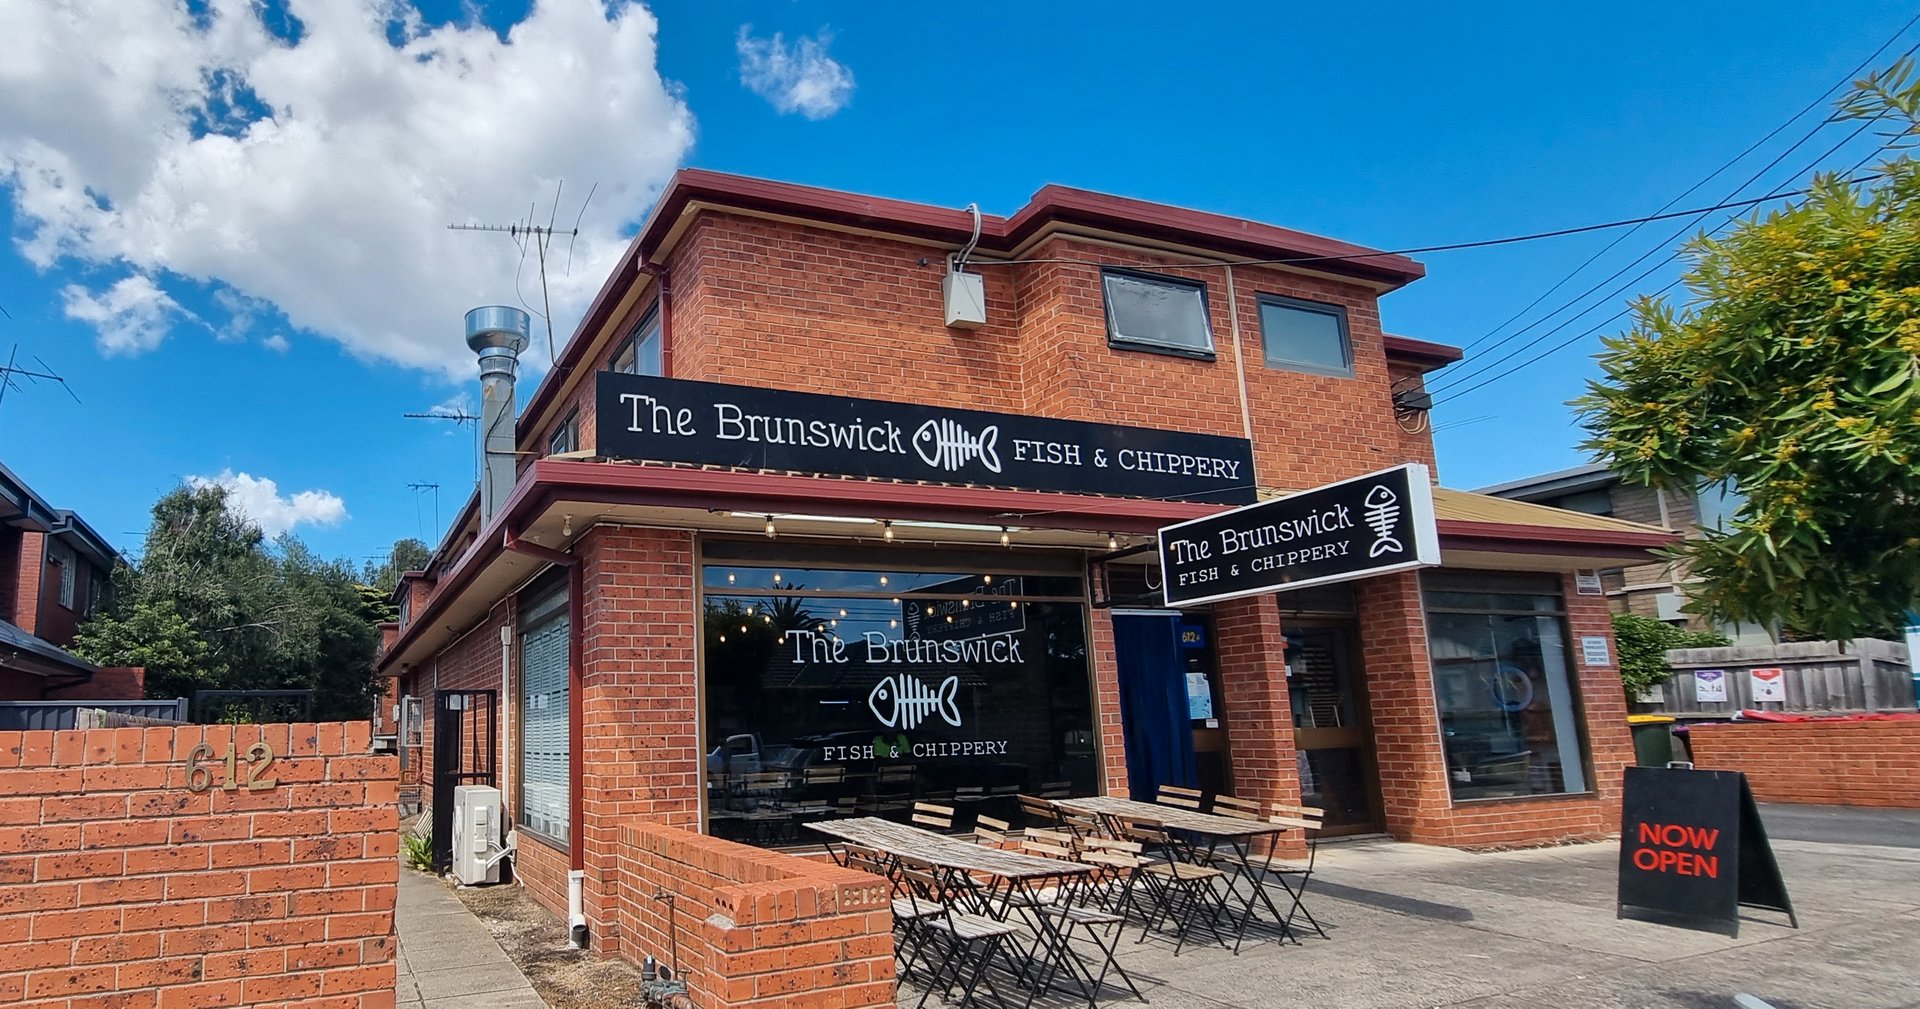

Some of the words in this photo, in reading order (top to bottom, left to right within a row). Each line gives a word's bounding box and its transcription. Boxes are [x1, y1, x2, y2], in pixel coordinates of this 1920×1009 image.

[619, 393, 697, 436] The
[713, 402, 907, 455] Brunswick
[1012, 439, 1082, 466] FISH
[1094, 448, 1108, 468] &
[1118, 449, 1241, 480] CHIPPERY
[1172, 539, 1212, 565] The
[1218, 503, 1355, 555] Brunswick
[1178, 567, 1220, 586] FISH
[1230, 564, 1240, 577] &
[1251, 540, 1350, 572] CHIPPERY
[785, 629, 848, 664] The
[862, 631, 1025, 664] Brunswick
[185, 742, 278, 792] 612
[823, 745, 875, 761] FISH
[889, 745, 899, 759] &
[912, 740, 1008, 758] CHIPPERY
[1639, 822, 1719, 851] NOW
[1633, 847, 1718, 879] OPEN
